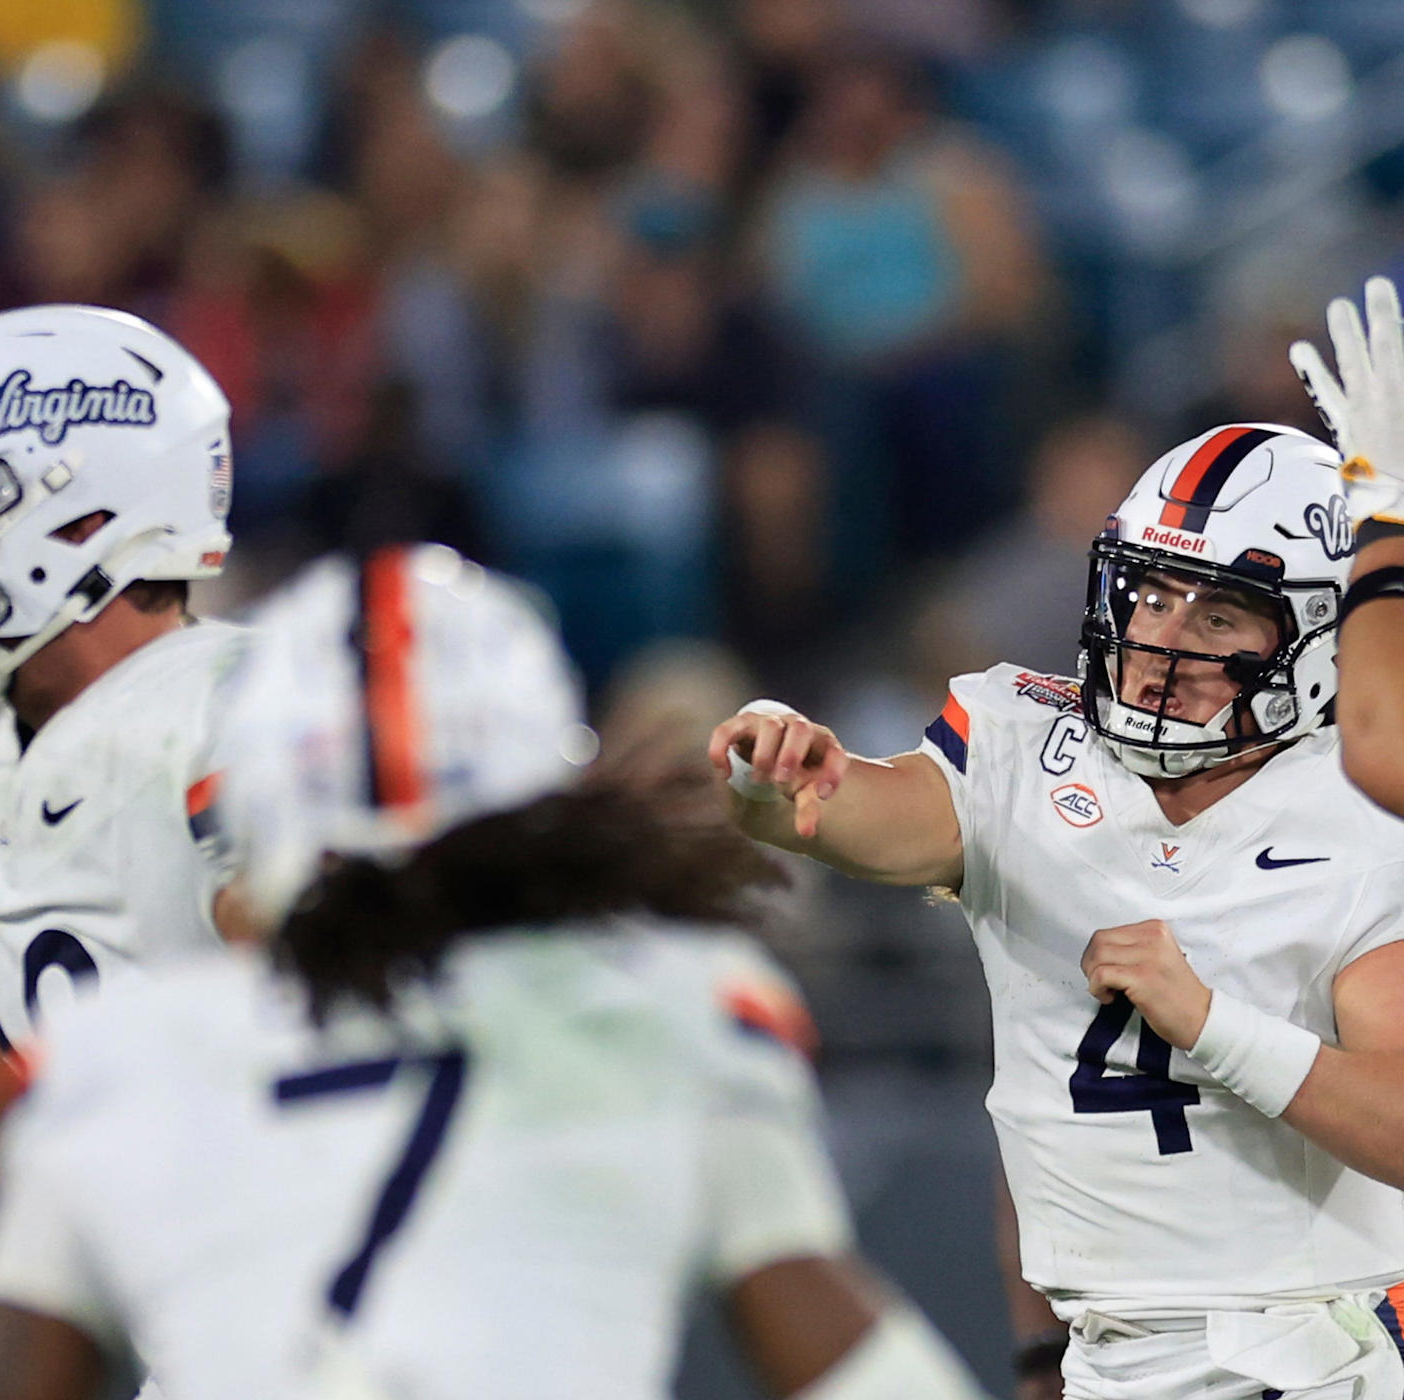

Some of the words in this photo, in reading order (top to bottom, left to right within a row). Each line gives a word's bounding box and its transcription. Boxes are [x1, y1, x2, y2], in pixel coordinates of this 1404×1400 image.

[1142, 526, 1207, 554] Riddell
[1040, 714, 1088, 776] C
[1125, 716, 1168, 736] Riddel
[1059, 793, 1097, 815] ACC
[1070, 990, 1200, 1155] 4
[273, 1046, 466, 1320] 7
